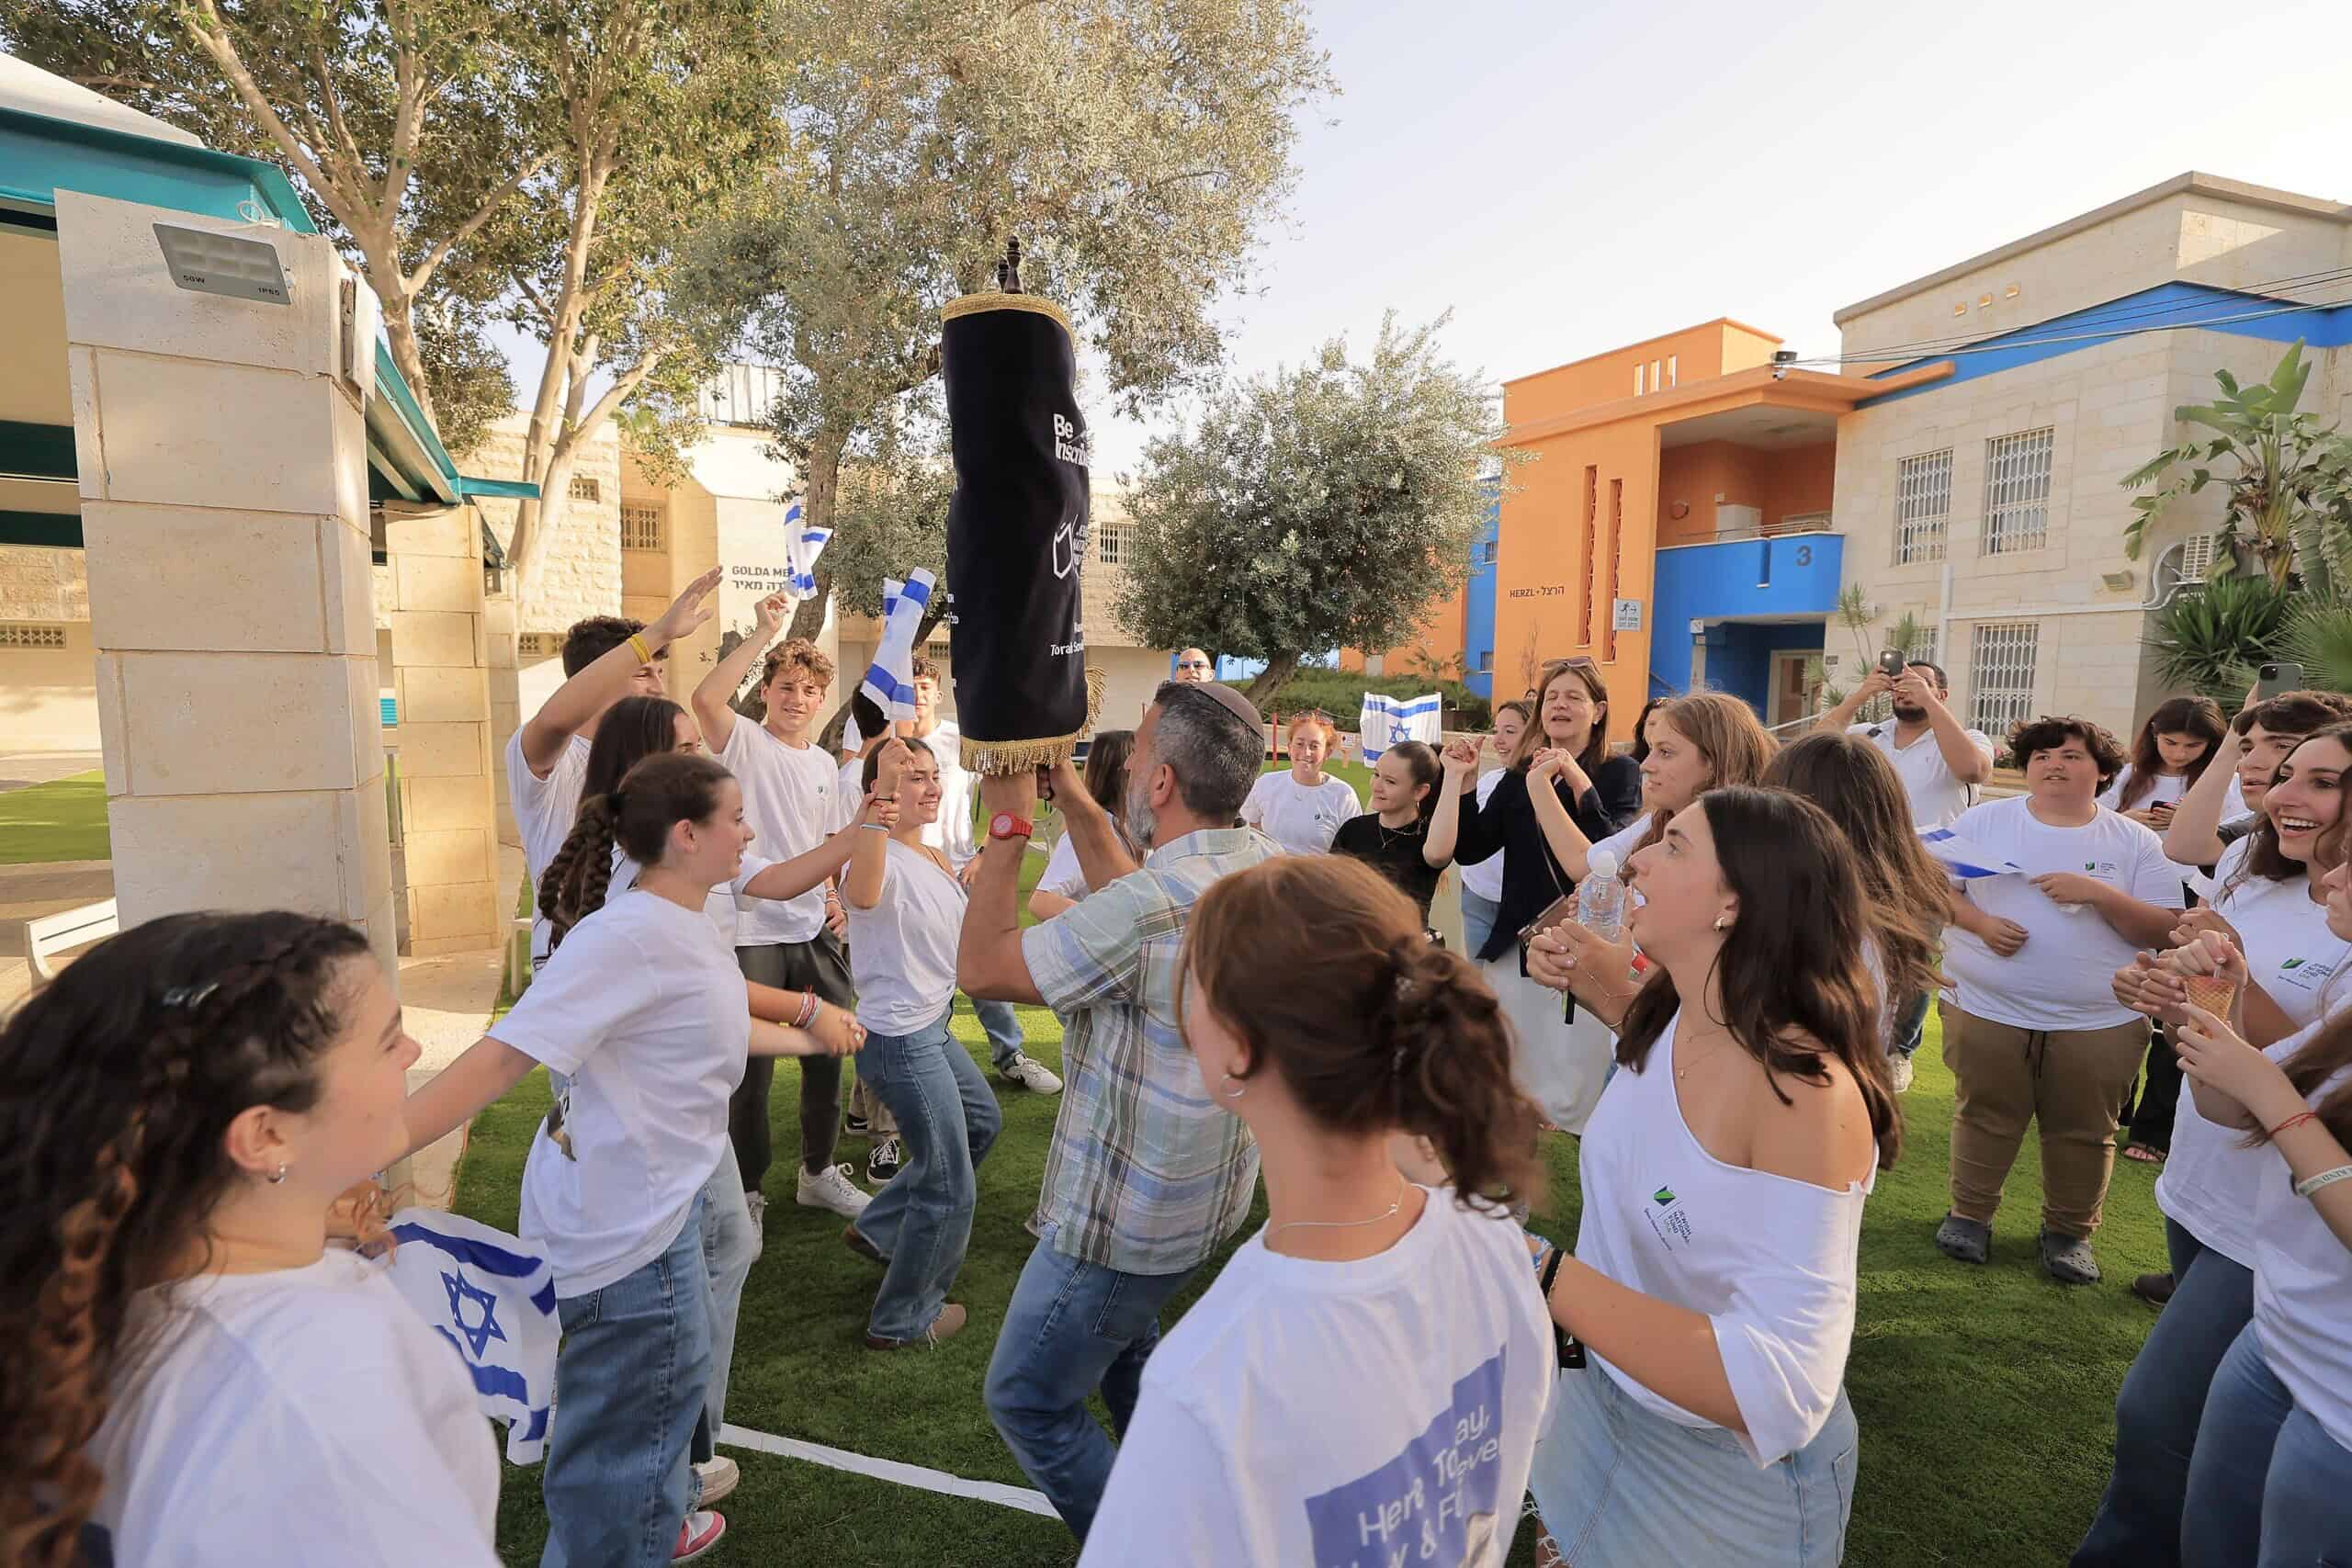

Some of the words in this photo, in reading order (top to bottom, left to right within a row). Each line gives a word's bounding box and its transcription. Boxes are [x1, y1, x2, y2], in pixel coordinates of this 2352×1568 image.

[1053, 412, 1074, 439] Be
[1795, 544, 1812, 567] 3
[731, 566, 770, 577] GOLDA
[773, 567, 789, 578] ME
[731, 580, 763, 591] מאיר
[1510, 588, 1535, 599] HERZL
[1541, 585, 1566, 596] הרצל
